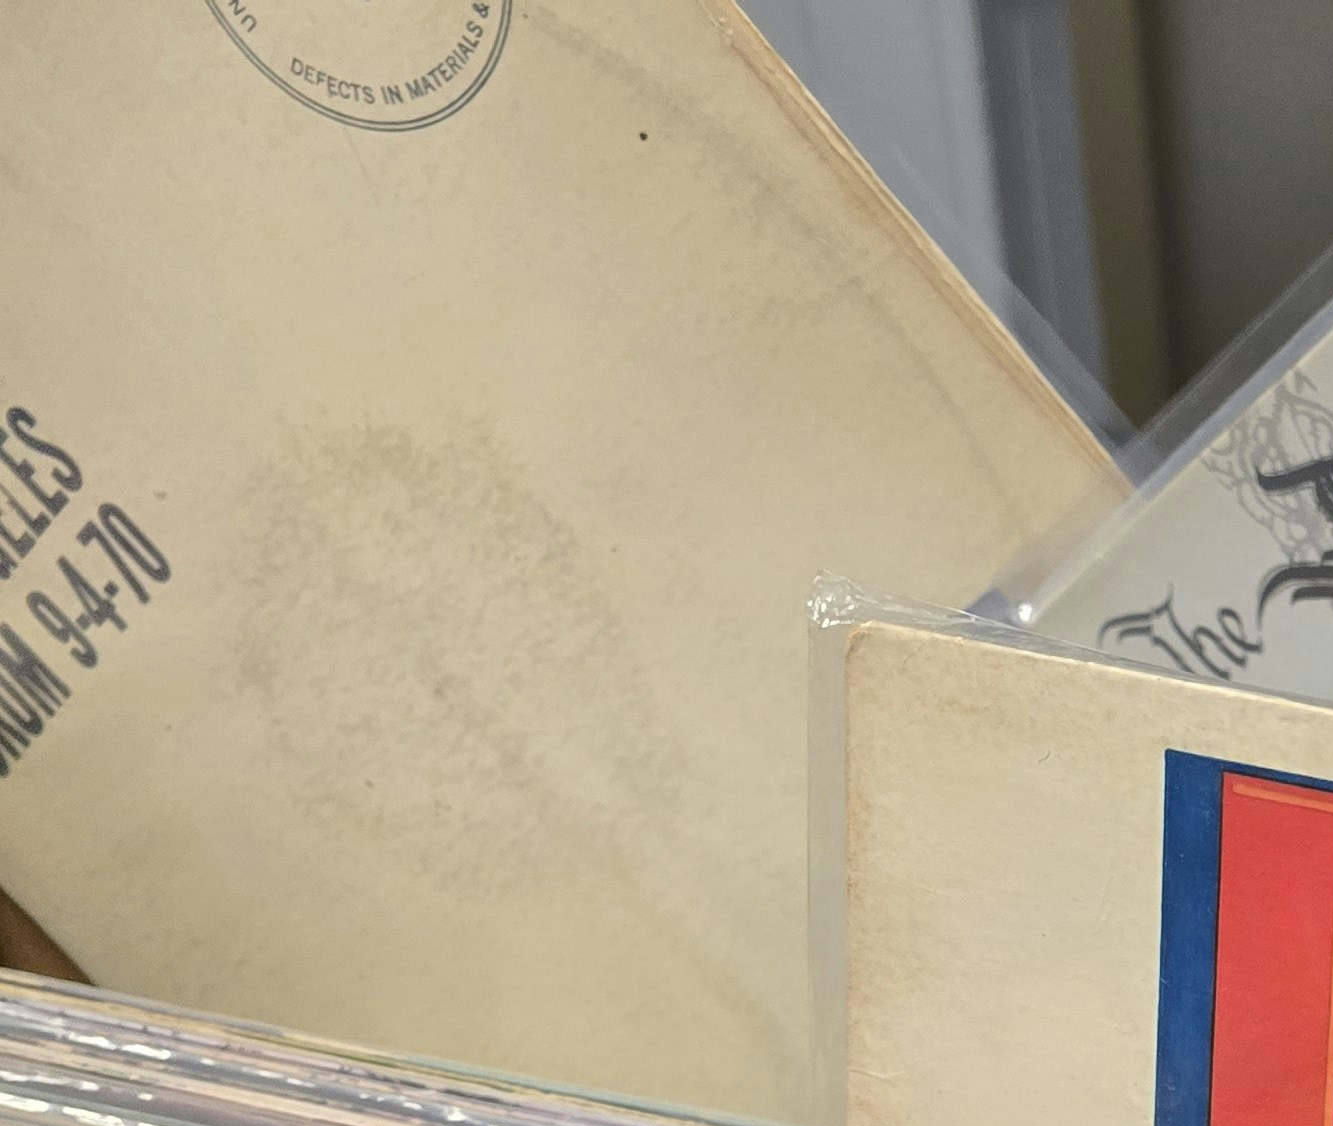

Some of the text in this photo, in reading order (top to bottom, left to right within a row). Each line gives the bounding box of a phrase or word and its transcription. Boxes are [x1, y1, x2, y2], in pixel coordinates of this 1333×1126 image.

[289, 1, 491, 106] DEFECTS IN MATERIALS &
[26, 503, 171, 669] 9-4-70
[1099, 582, 1262, 681] The
